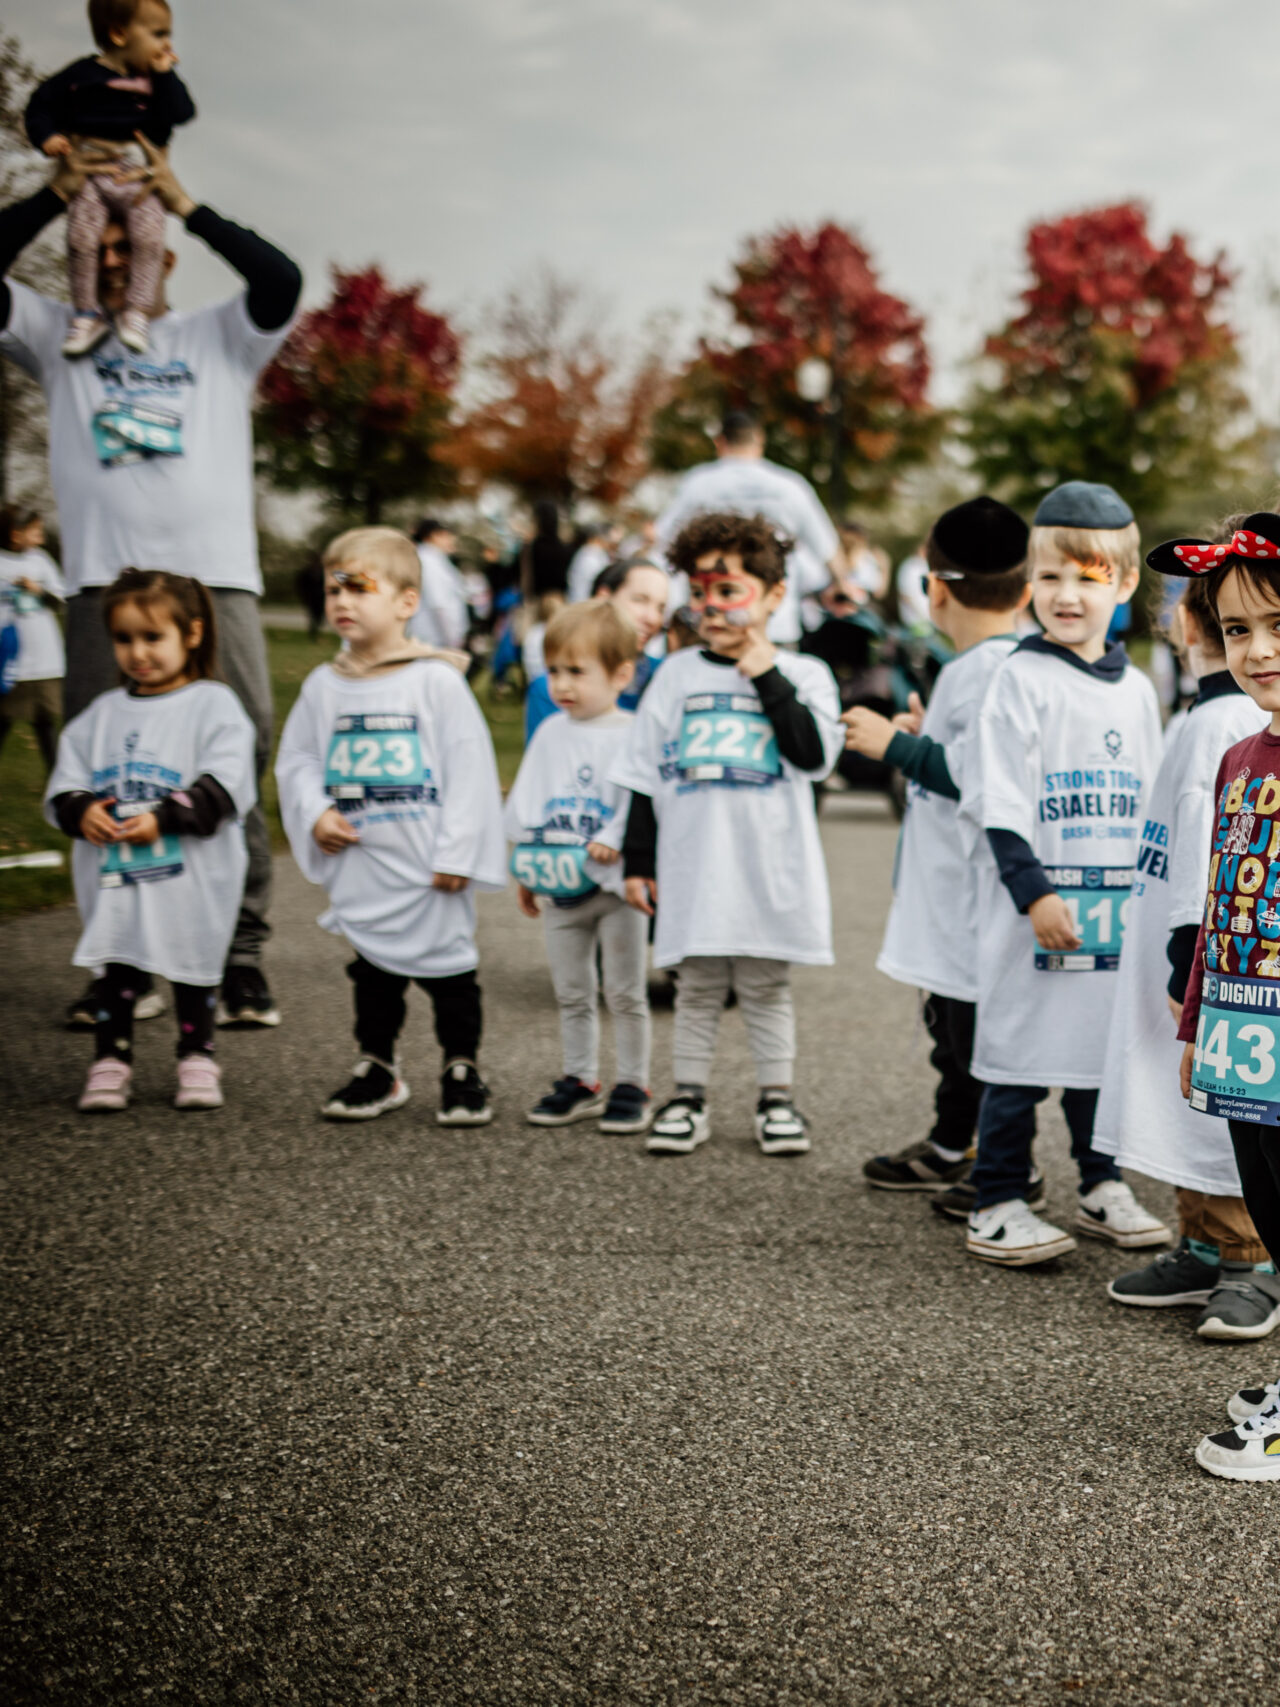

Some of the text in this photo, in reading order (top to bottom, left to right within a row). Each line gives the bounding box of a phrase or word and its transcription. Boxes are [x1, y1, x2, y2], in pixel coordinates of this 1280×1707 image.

[685, 719, 774, 760] 227
[329, 738, 416, 777] 423
[1045, 769, 1106, 792] STRONG
[1039, 793, 1105, 822] ISRAEL
[515, 851, 583, 890] 530
[1215, 1096, 1268, 1112] InjuryLawyer.com
